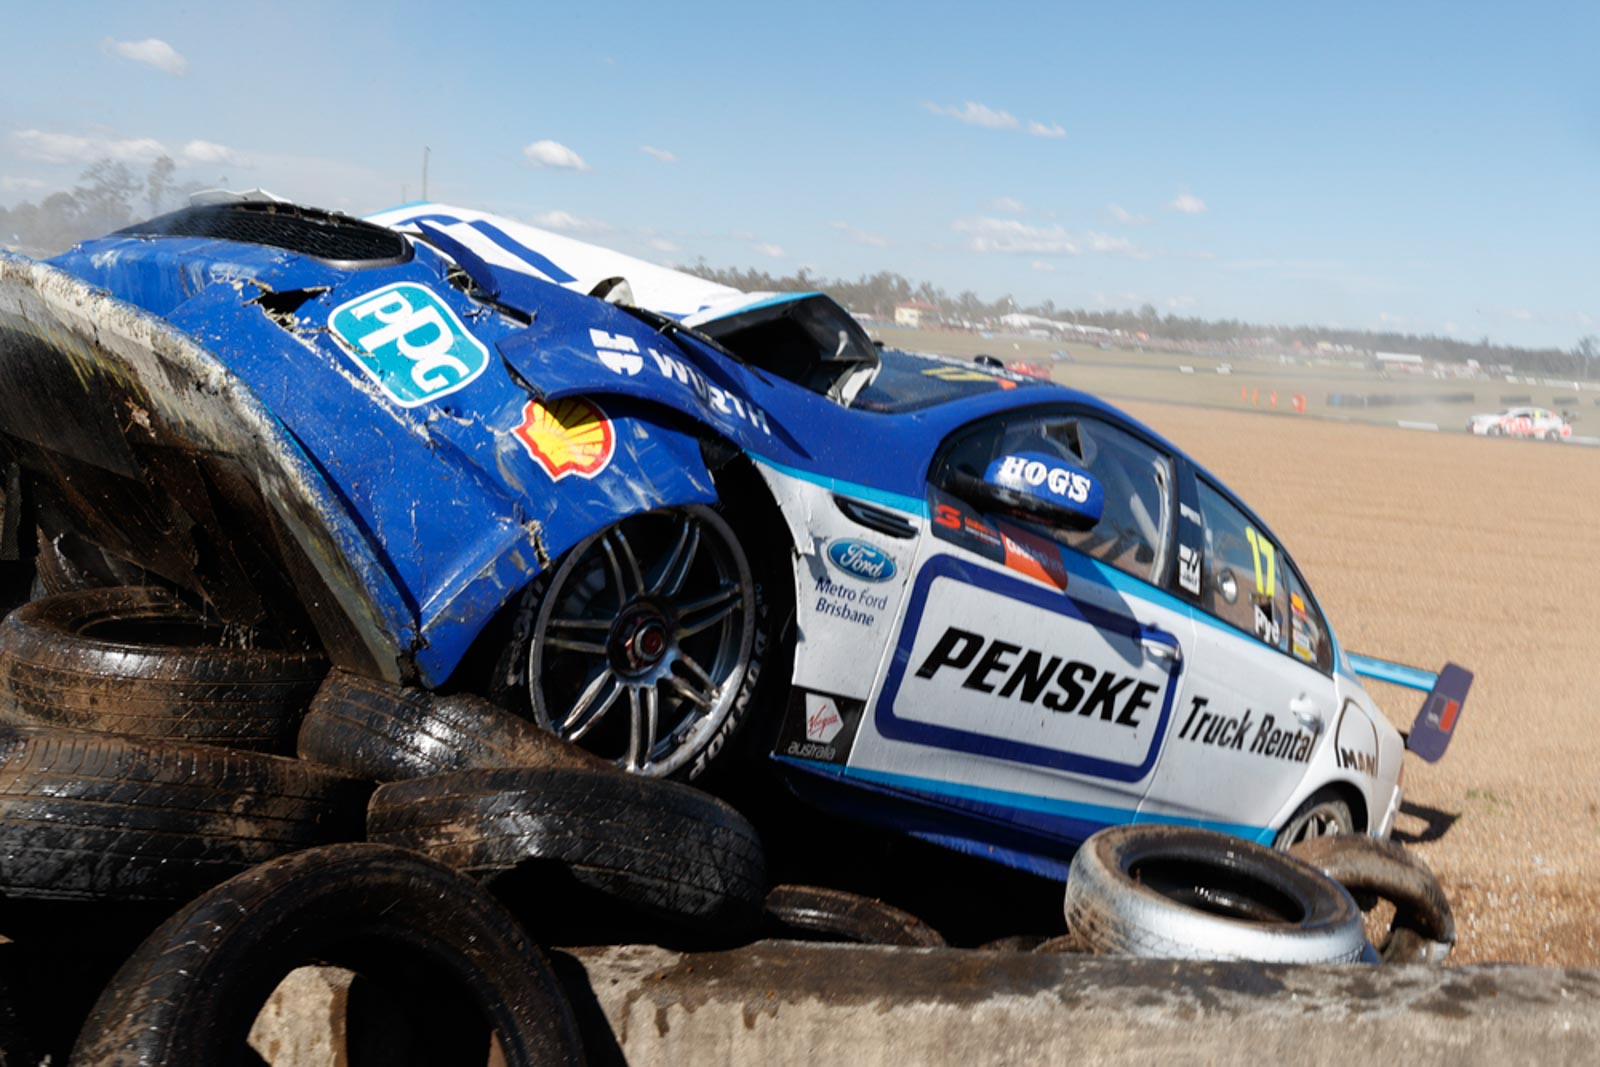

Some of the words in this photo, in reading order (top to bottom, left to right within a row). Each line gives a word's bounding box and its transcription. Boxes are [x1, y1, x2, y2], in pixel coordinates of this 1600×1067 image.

[350, 289, 470, 394] PPG
[839, 543, 885, 579] Ford
[1245, 526, 1275, 597] 17
[815, 579, 857, 602] Metro
[858, 589, 888, 611] Ford
[815, 597, 875, 627] Brisbane
[1254, 604, 1281, 643] Pye
[914, 626, 1161, 728] PENSKE
[1177, 695, 1250, 750] Truck
[1248, 713, 1319, 764] Rental
[787, 741, 837, 761] australia
